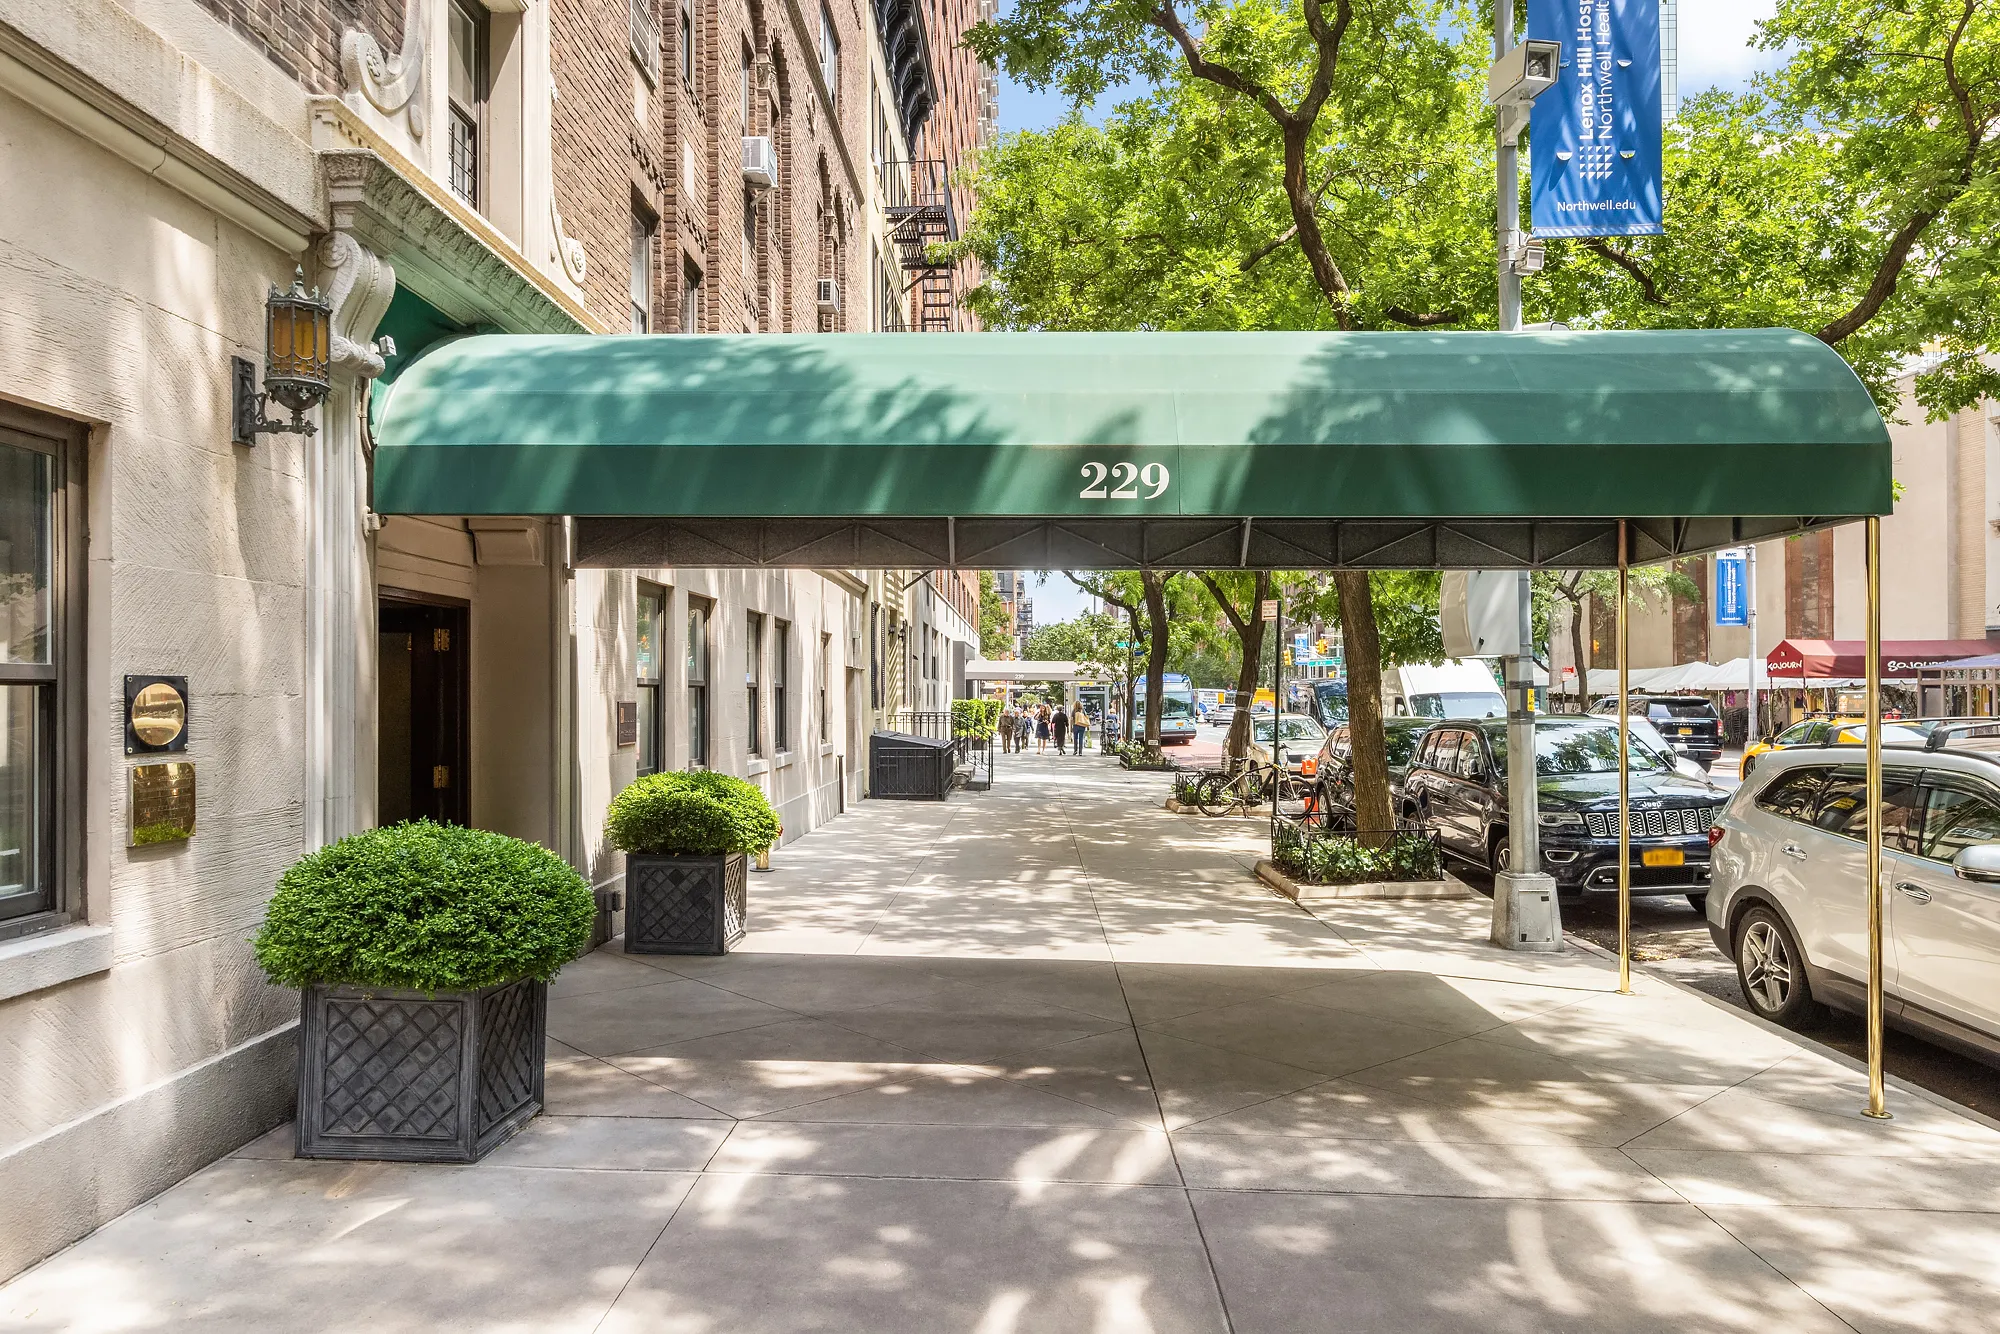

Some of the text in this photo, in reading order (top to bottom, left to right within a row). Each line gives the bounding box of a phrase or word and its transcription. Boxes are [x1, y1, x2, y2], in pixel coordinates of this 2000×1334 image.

[1576, 47, 1593, 77] Hill
[1579, 83, 1594, 140] Lenox
[1596, 51, 1613, 139] Northwell
[1557, 199, 1636, 212] Northwell.edu
[1080, 462, 1170, 499] 229
[1641, 801, 1662, 809] Jeep
